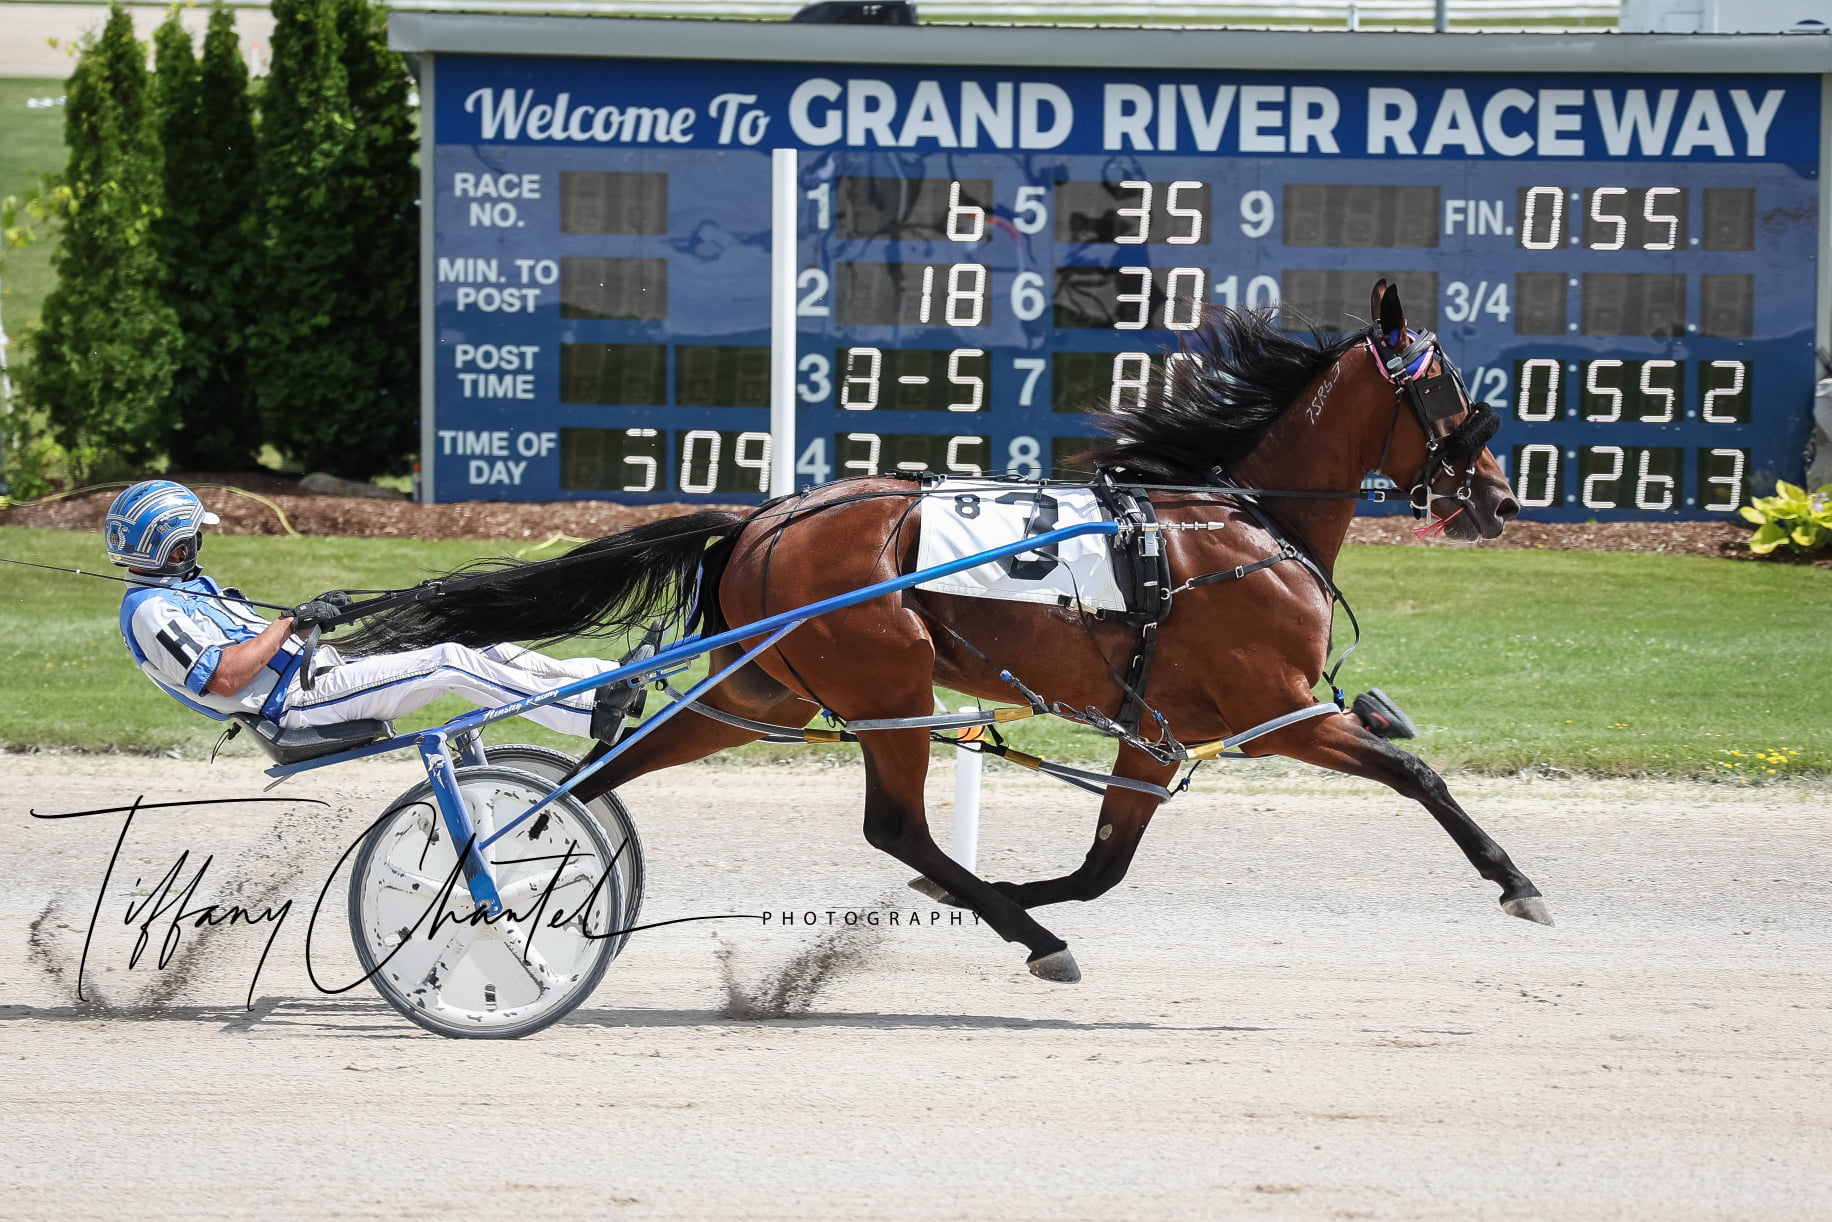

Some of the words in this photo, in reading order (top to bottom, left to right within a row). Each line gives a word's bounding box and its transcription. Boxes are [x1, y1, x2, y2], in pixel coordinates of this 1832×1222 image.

[464, 87, 696, 143] Welcome
[708, 93, 771, 146] To
[788, 78, 1075, 150] GRAND
[1103, 83, 1341, 154] RIVER
[1366, 87, 1786, 157] RACEWAY
[454, 172, 541, 199] RACE
[807, 183, 830, 230] 1
[470, 201, 525, 228] NO.
[946, 181, 985, 242] 6
[1013, 186, 1047, 234] 5
[1114, 181, 1203, 245] 35
[1240, 190, 1274, 238] 9
[1445, 200, 1514, 235] FIN.
[438, 257, 507, 283] MIN.
[514, 258, 559, 285] TO
[797, 268, 830, 316] 2
[456, 287, 541, 313] POST
[920, 263, 986, 327] 18
[1010, 272, 1045, 321] 6
[1113, 266, 1205, 331] 30
[1215, 274, 1280, 320] 10
[1444, 281, 1510, 322] 3/4
[455, 344, 540, 371] POST
[797, 353, 832, 403] 3
[457, 373, 535, 399] TIME
[1013, 359, 1046, 406] 7
[1459, 366, 1508, 407] /2
[438, 430, 510, 456] TIME
[517, 431, 557, 457] OF
[796, 437, 831, 484] 4
[1006, 436, 1041, 480] 8
[469, 460, 527, 485] DAY
[955, 494, 980, 519] 8
